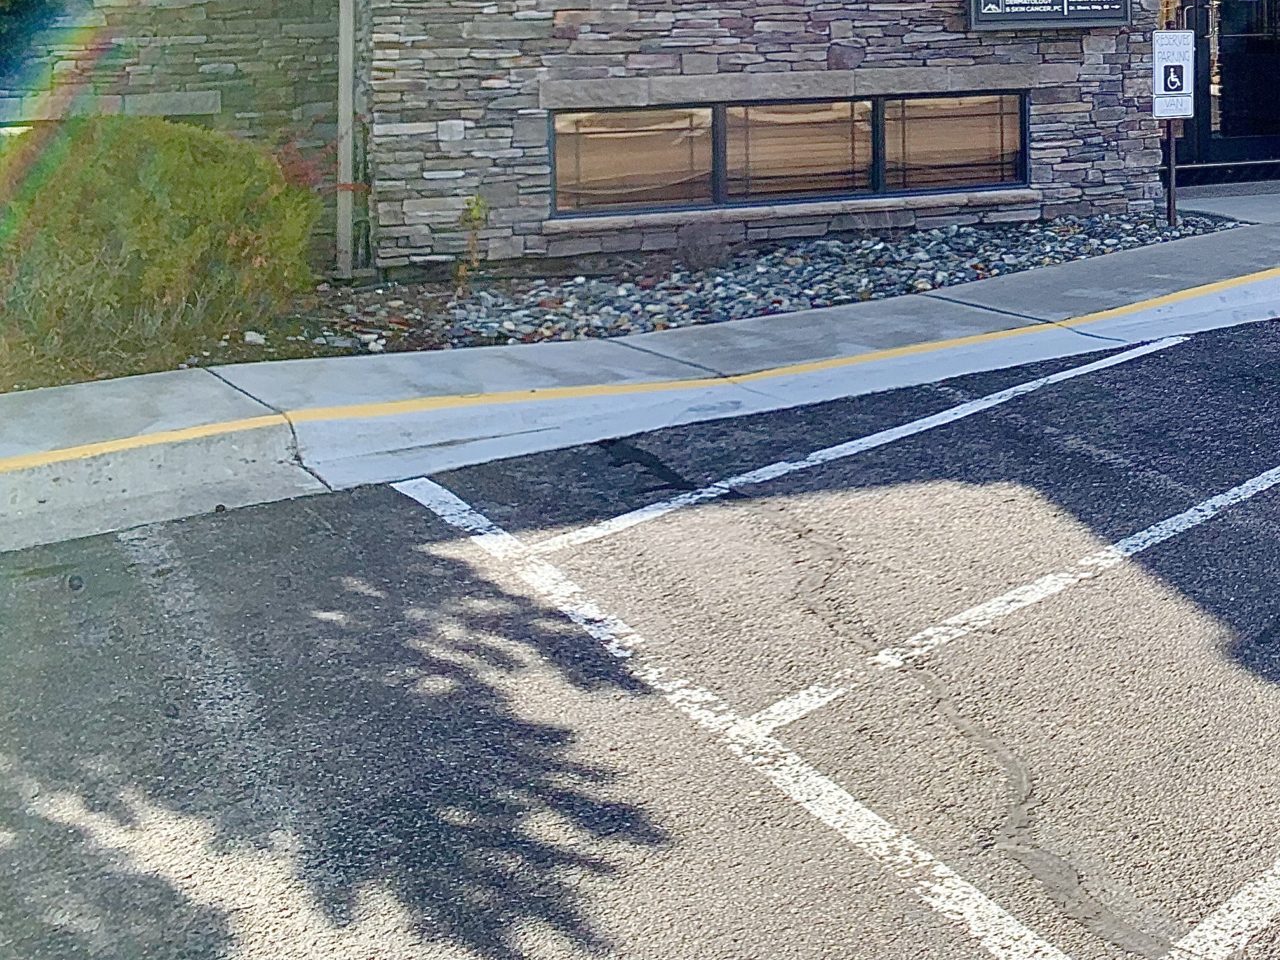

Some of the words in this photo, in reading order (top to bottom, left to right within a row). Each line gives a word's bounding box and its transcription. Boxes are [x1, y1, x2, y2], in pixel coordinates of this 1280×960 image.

[1156, 34, 1192, 47] RESERVED
[1157, 50, 1190, 63] PARKING
[1164, 98, 1184, 108] VAN
